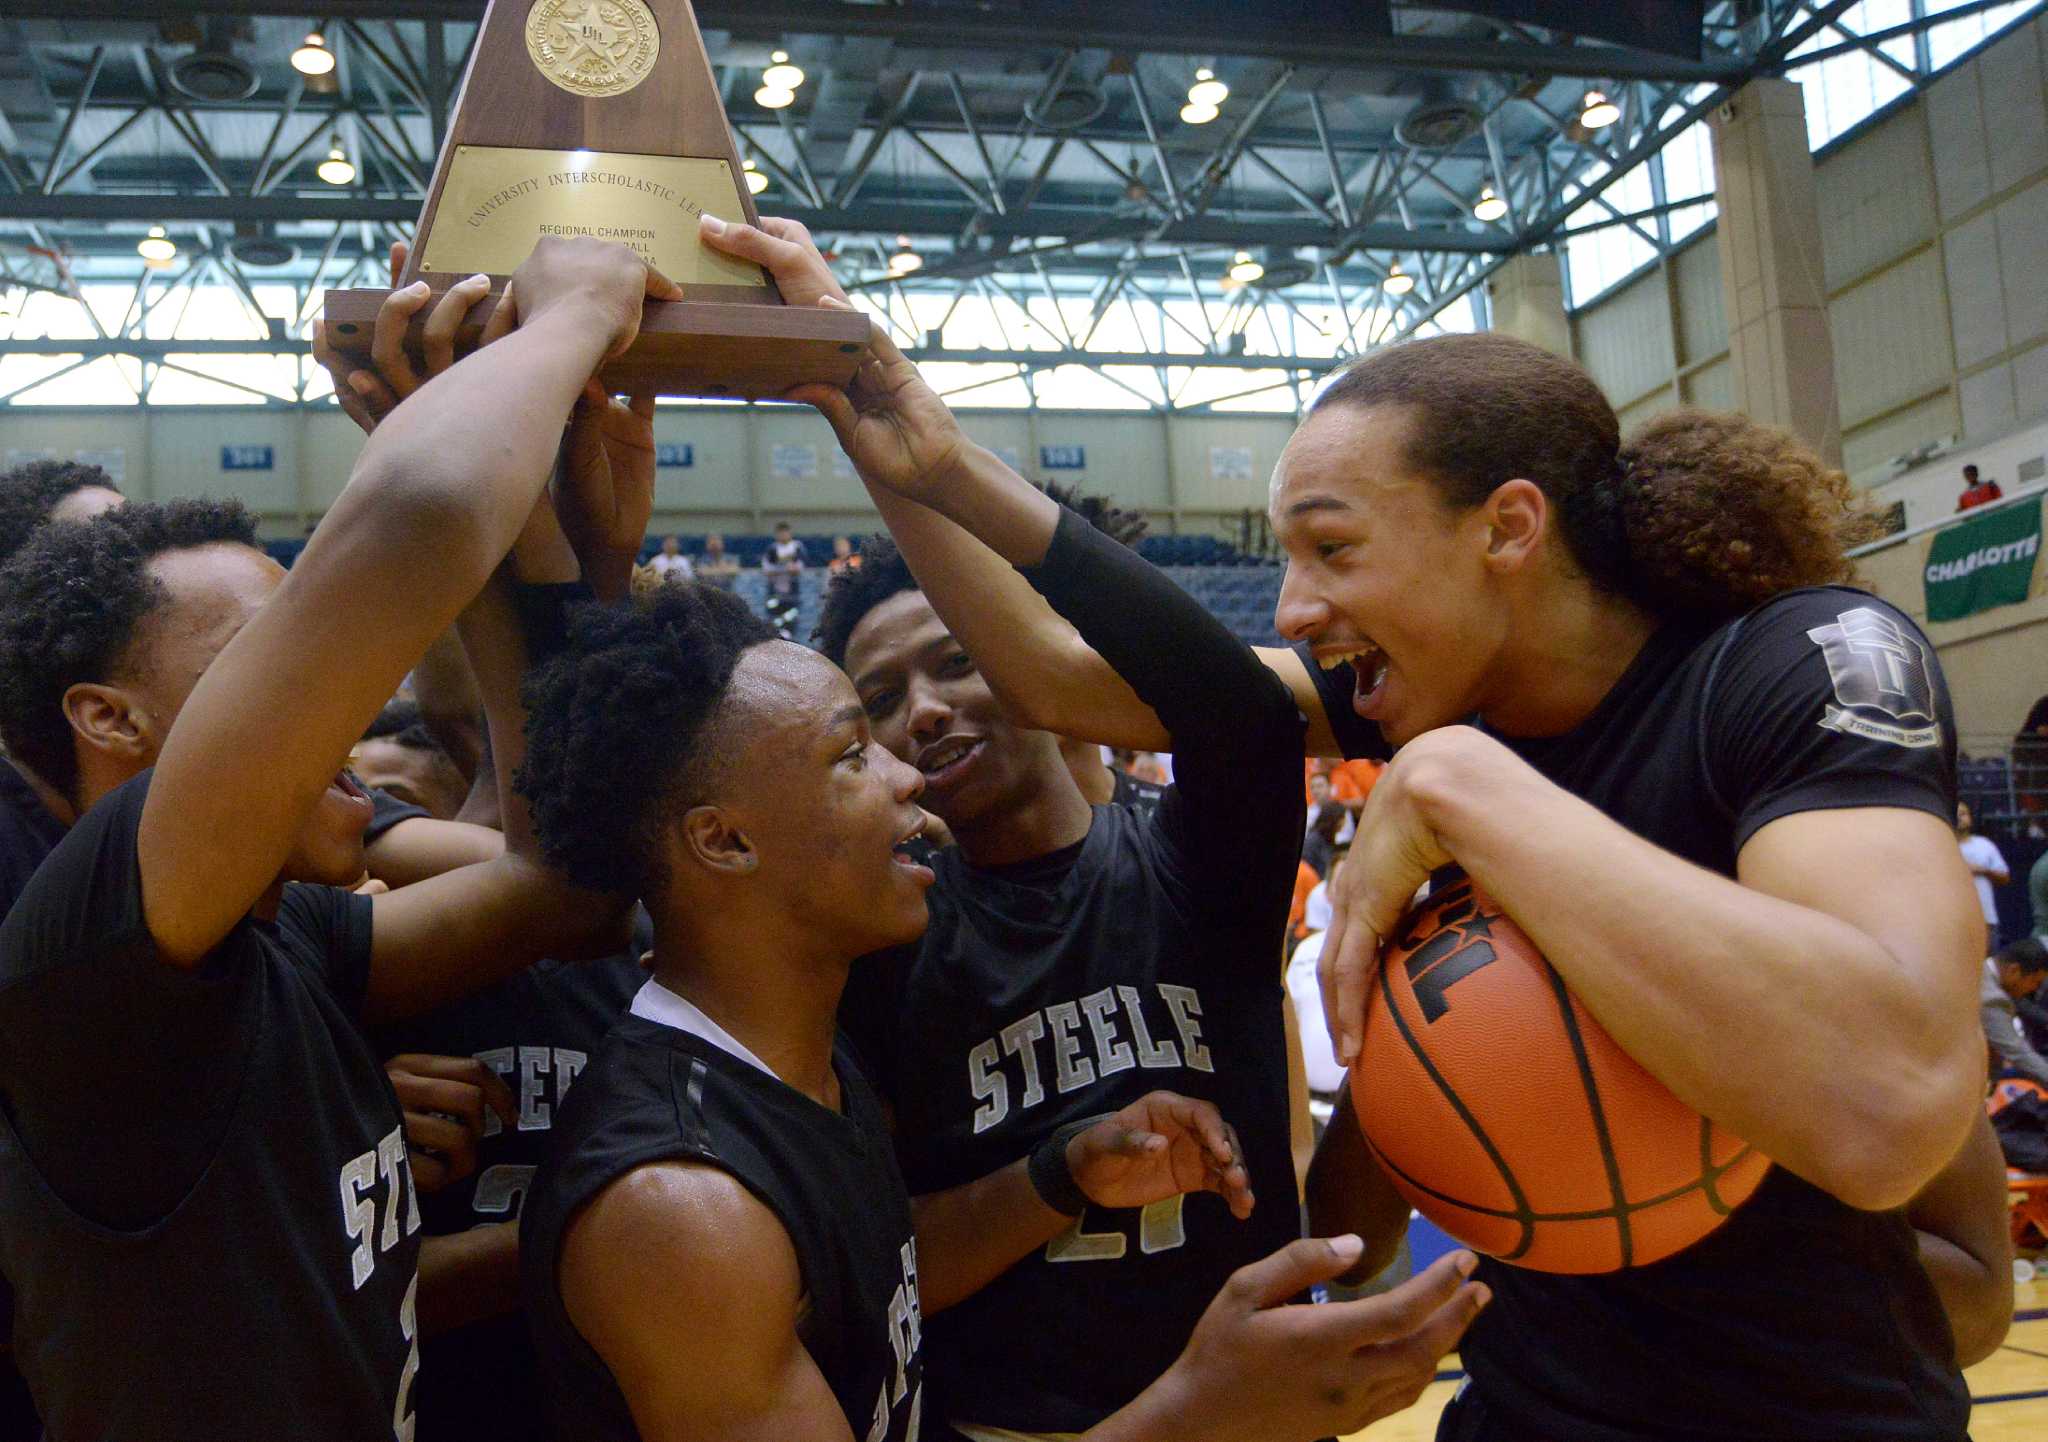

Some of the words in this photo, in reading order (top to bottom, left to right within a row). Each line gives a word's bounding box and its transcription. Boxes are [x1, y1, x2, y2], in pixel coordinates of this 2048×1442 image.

[582, 25, 608, 45] UIL
[467, 177, 539, 228] UNIVERSITY
[548, 172, 675, 201] INTERSCHOLASTIC
[679, 197, 703, 220] LEA
[539, 224, 593, 236] REGIONAL
[598, 227, 656, 239] CHAMPION
[1926, 533, 2040, 583] CHARLOTTE
[968, 983, 1215, 1134] STEELE
